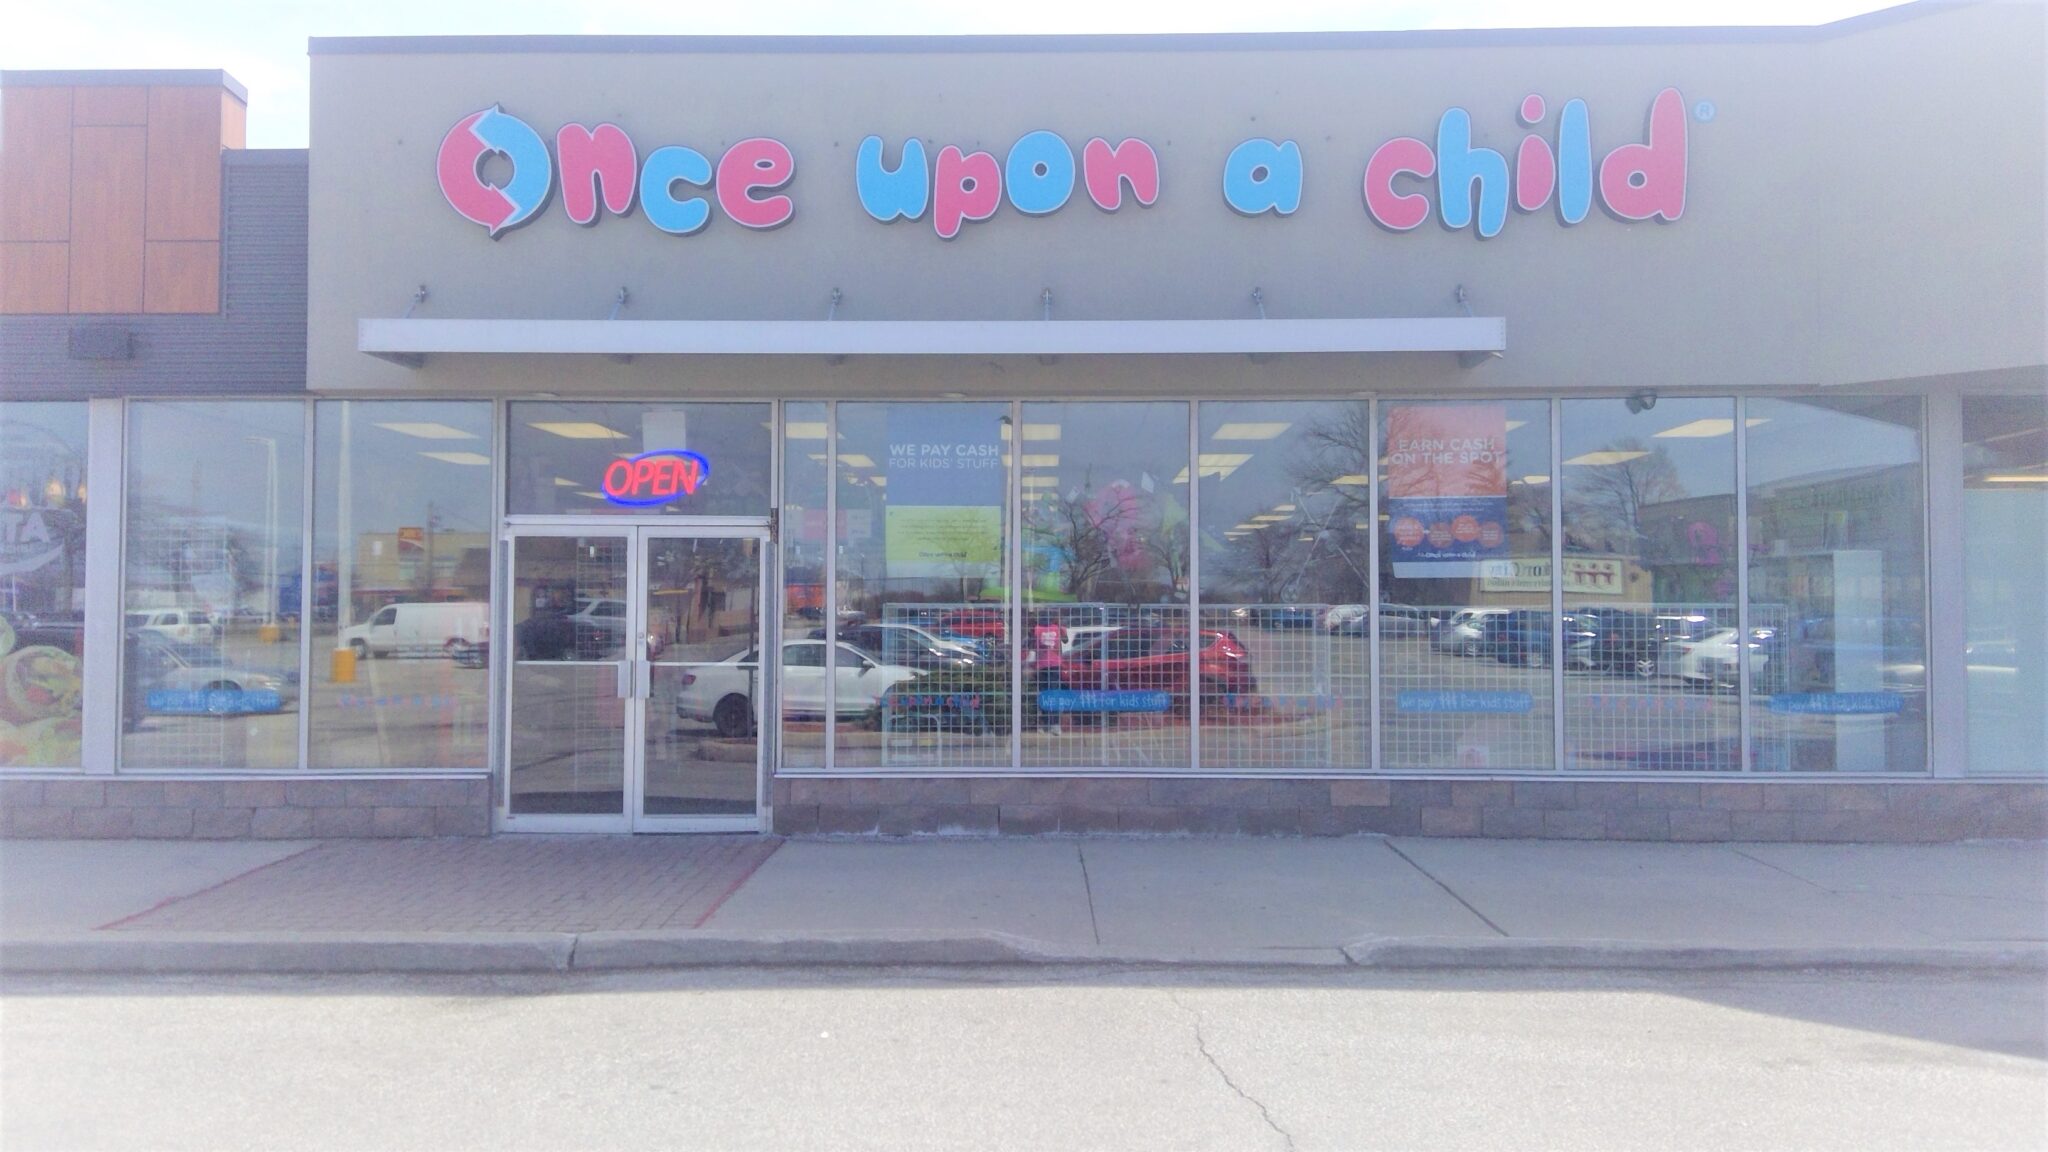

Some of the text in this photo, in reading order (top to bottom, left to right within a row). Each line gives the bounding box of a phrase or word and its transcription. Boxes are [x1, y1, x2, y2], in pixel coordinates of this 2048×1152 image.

[437, 104, 796, 239] Once
[855, 129, 1160, 239] upon
[1222, 136, 1303, 216] a
[1363, 87, 1689, 238] child
[889, 443, 999, 457] WE PAY CASH
[1399, 438, 1495, 452] EARN CASH
[888, 458, 917, 470] FOR
[957, 458, 999, 470] STUFF
[1391, 451, 1504, 466] ON THE SPOT
[604, 458, 699, 497] OPEN
[1060, 697, 1076, 711] pay
